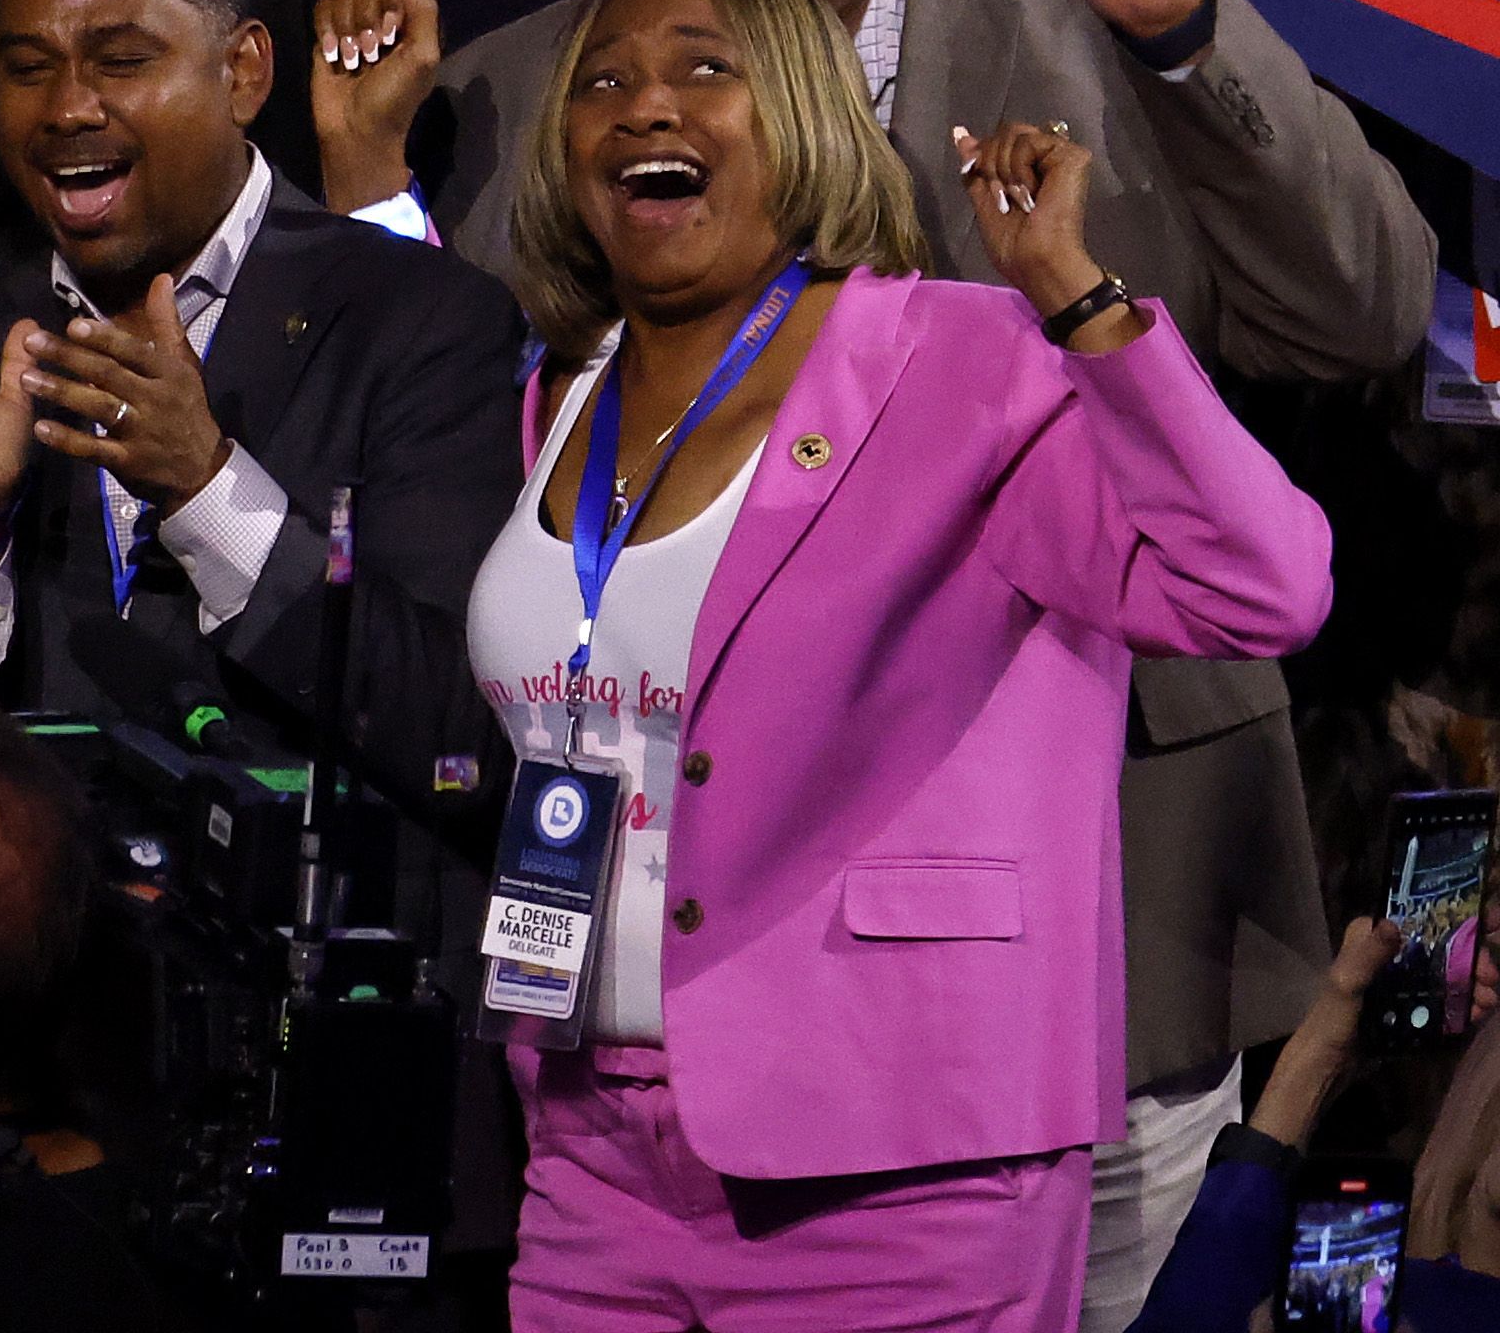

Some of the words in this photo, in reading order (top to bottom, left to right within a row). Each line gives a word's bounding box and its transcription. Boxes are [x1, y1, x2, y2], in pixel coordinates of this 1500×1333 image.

[522, 662, 626, 718] votng
[504, 904, 518, 921] C.
[521, 906, 574, 931] DENISE
[496, 920, 574, 949] MARCELLE
[508, 939, 556, 960] DELEGATE
